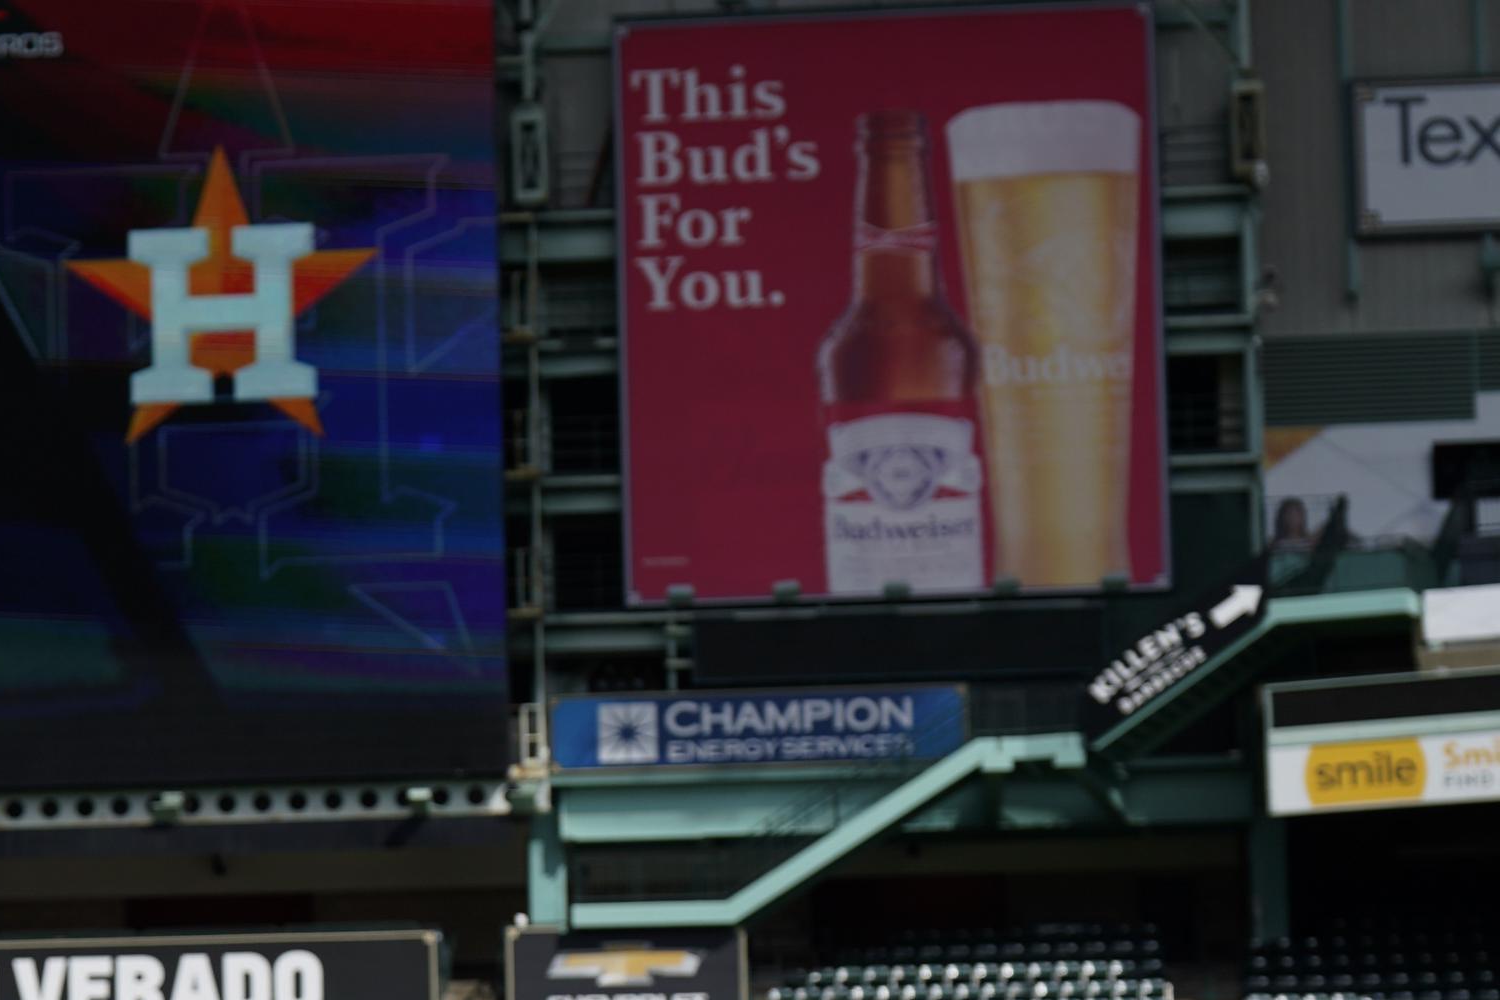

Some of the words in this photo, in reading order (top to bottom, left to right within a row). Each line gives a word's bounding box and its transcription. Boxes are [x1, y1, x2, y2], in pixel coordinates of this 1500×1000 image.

[631, 66, 786, 122] This
[636, 127, 820, 186] Bud's
[636, 196, 751, 248] For
[636, 256, 786, 311] You.
[1088, 611, 1206, 704] KILLEN'S
[664, 696, 914, 737] CHAMPION
[666, 737, 778, 763] ENERGY
[1315, 751, 1417, 790] smile
